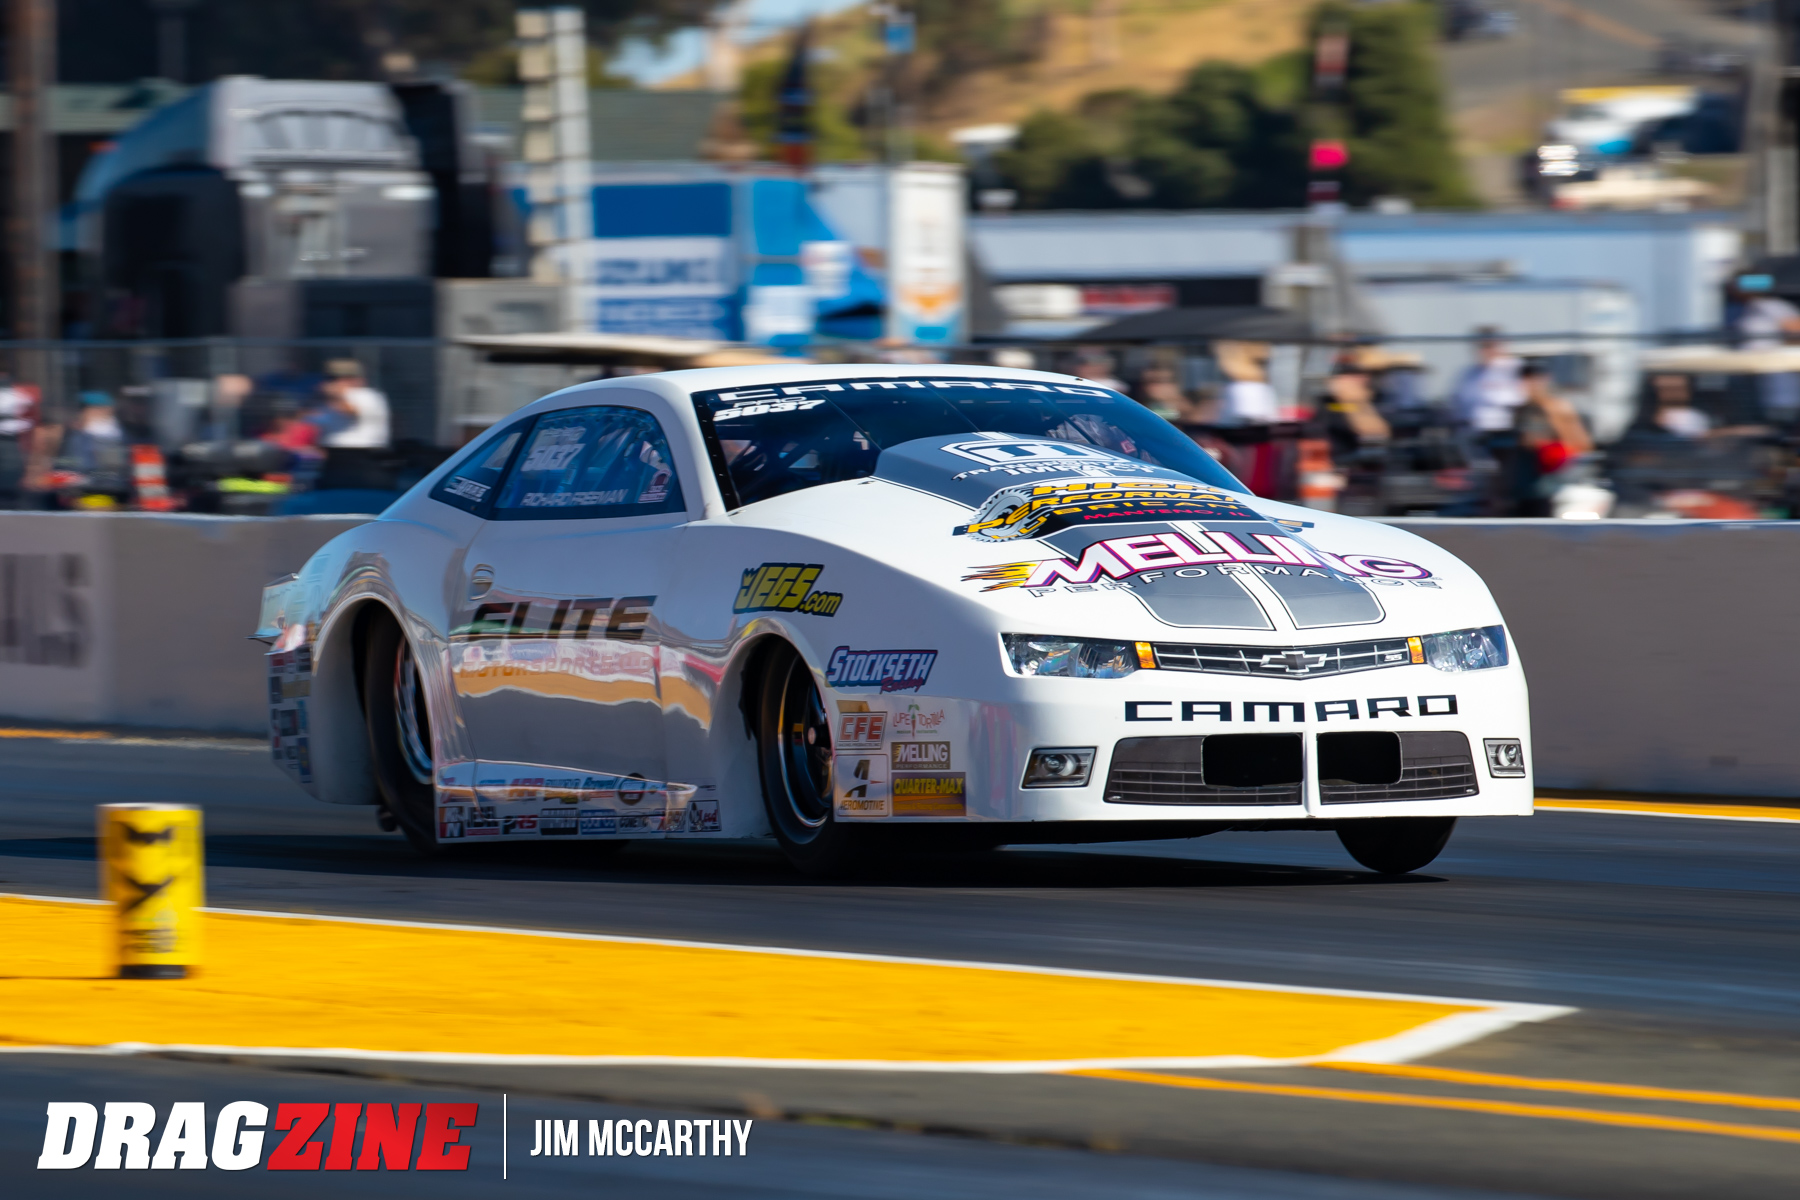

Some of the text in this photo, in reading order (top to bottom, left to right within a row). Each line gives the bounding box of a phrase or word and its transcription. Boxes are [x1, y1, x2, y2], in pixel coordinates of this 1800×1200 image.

[717, 380, 1113, 402] CAMARO
[713, 400, 826, 421] 5037
[521, 443, 586, 471] 5037
[520, 491, 571, 506] RICHARD
[571, 489, 628, 505] FREEMAN
[1084, 509, 1222, 521] MANTENO,
[1021, 530, 1433, 589] MELLING
[1029, 564, 1442, 598] PERFORMANCE
[468, 595, 658, 641] ELITE
[827, 647, 937, 687] STOCKSETH
[1125, 694, 1458, 723] CAMARO
[839, 716, 885, 741] CFE
[892, 712, 911, 728] LUPE
[896, 744, 948, 762] MELLING
[893, 778, 964, 794] QUARTER-MAX
[838, 799, 885, 811] AEROMOTIVE
